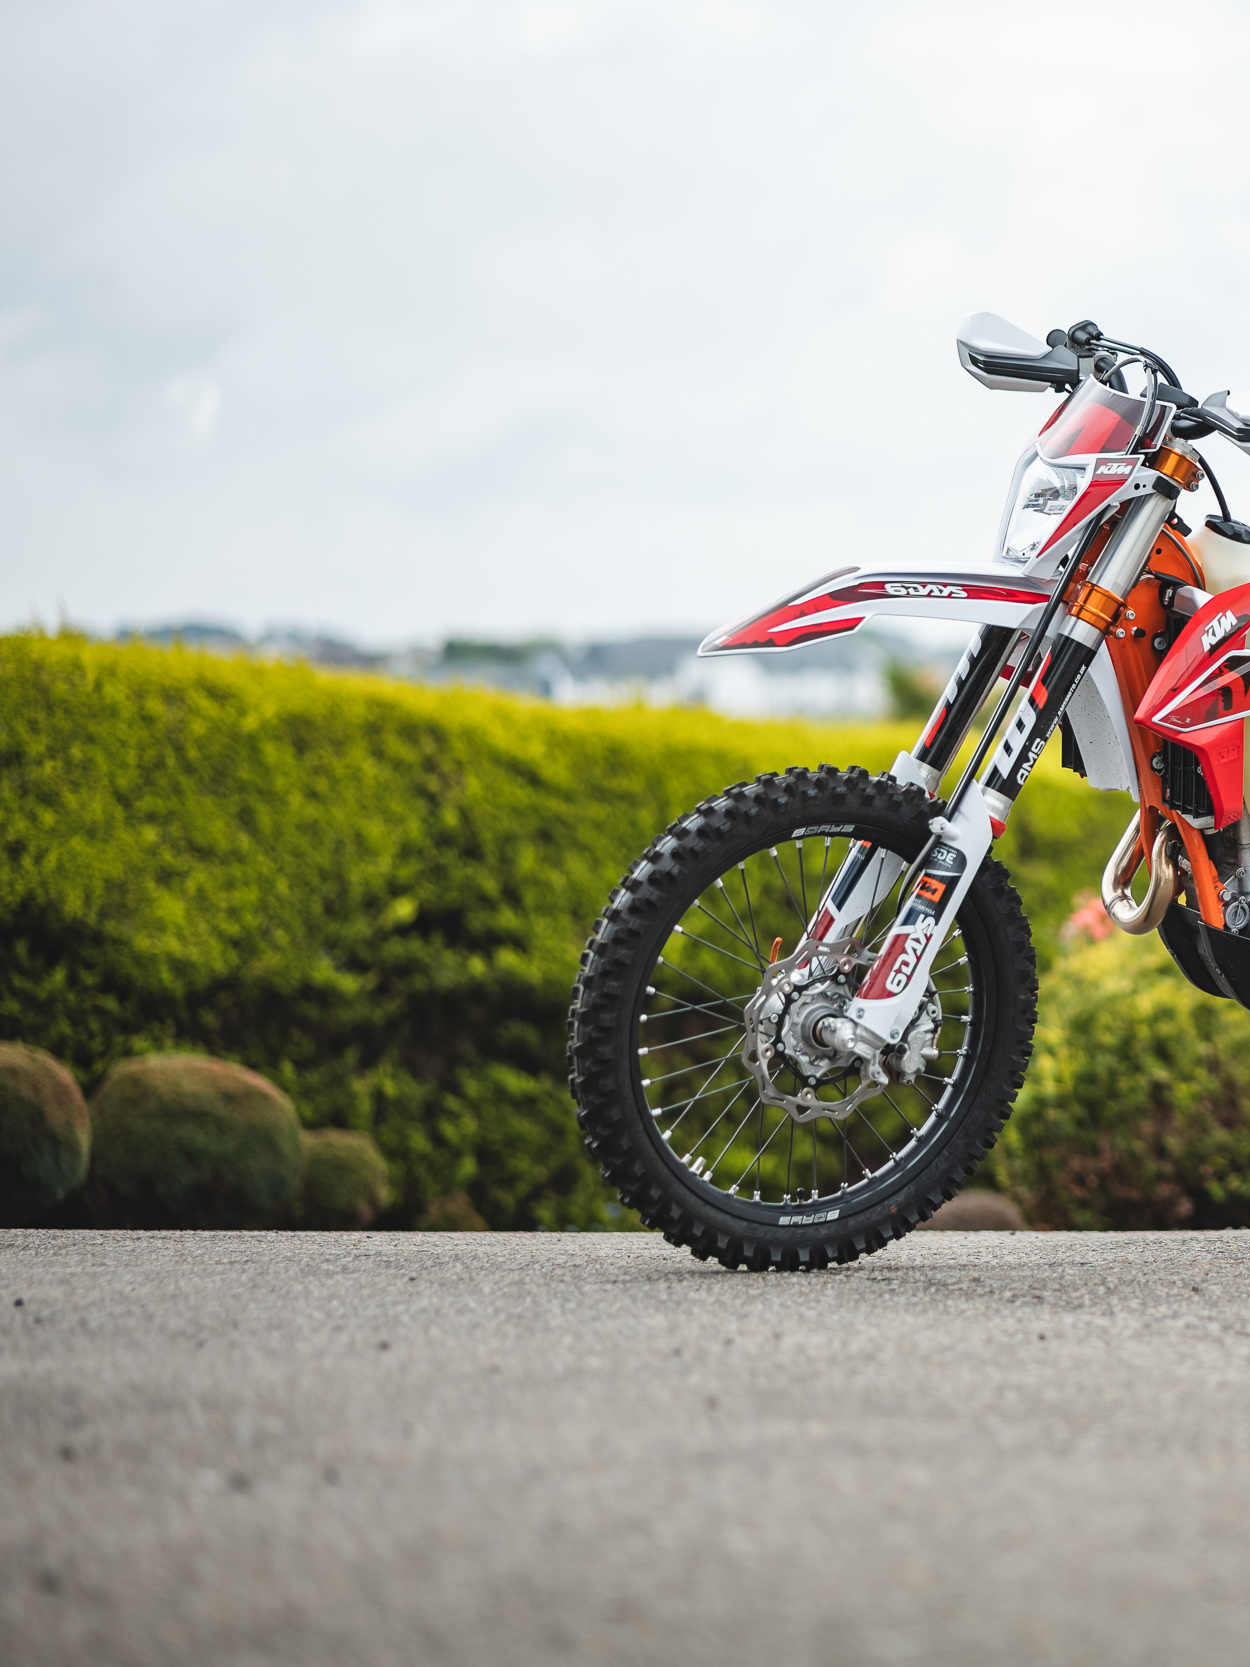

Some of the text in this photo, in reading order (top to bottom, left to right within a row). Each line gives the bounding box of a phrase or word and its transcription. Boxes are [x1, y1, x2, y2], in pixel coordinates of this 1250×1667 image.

[1095, 462, 1133, 475] KTM
[884, 583, 968, 598] 6DAYS
[1201, 609, 1238, 653] KTM
[1016, 737, 1046, 786] AMS
[791, 824, 855, 838] 6DAYS
[932, 847, 957, 865] SDE
[885, 913, 936, 994] 6DAYS
